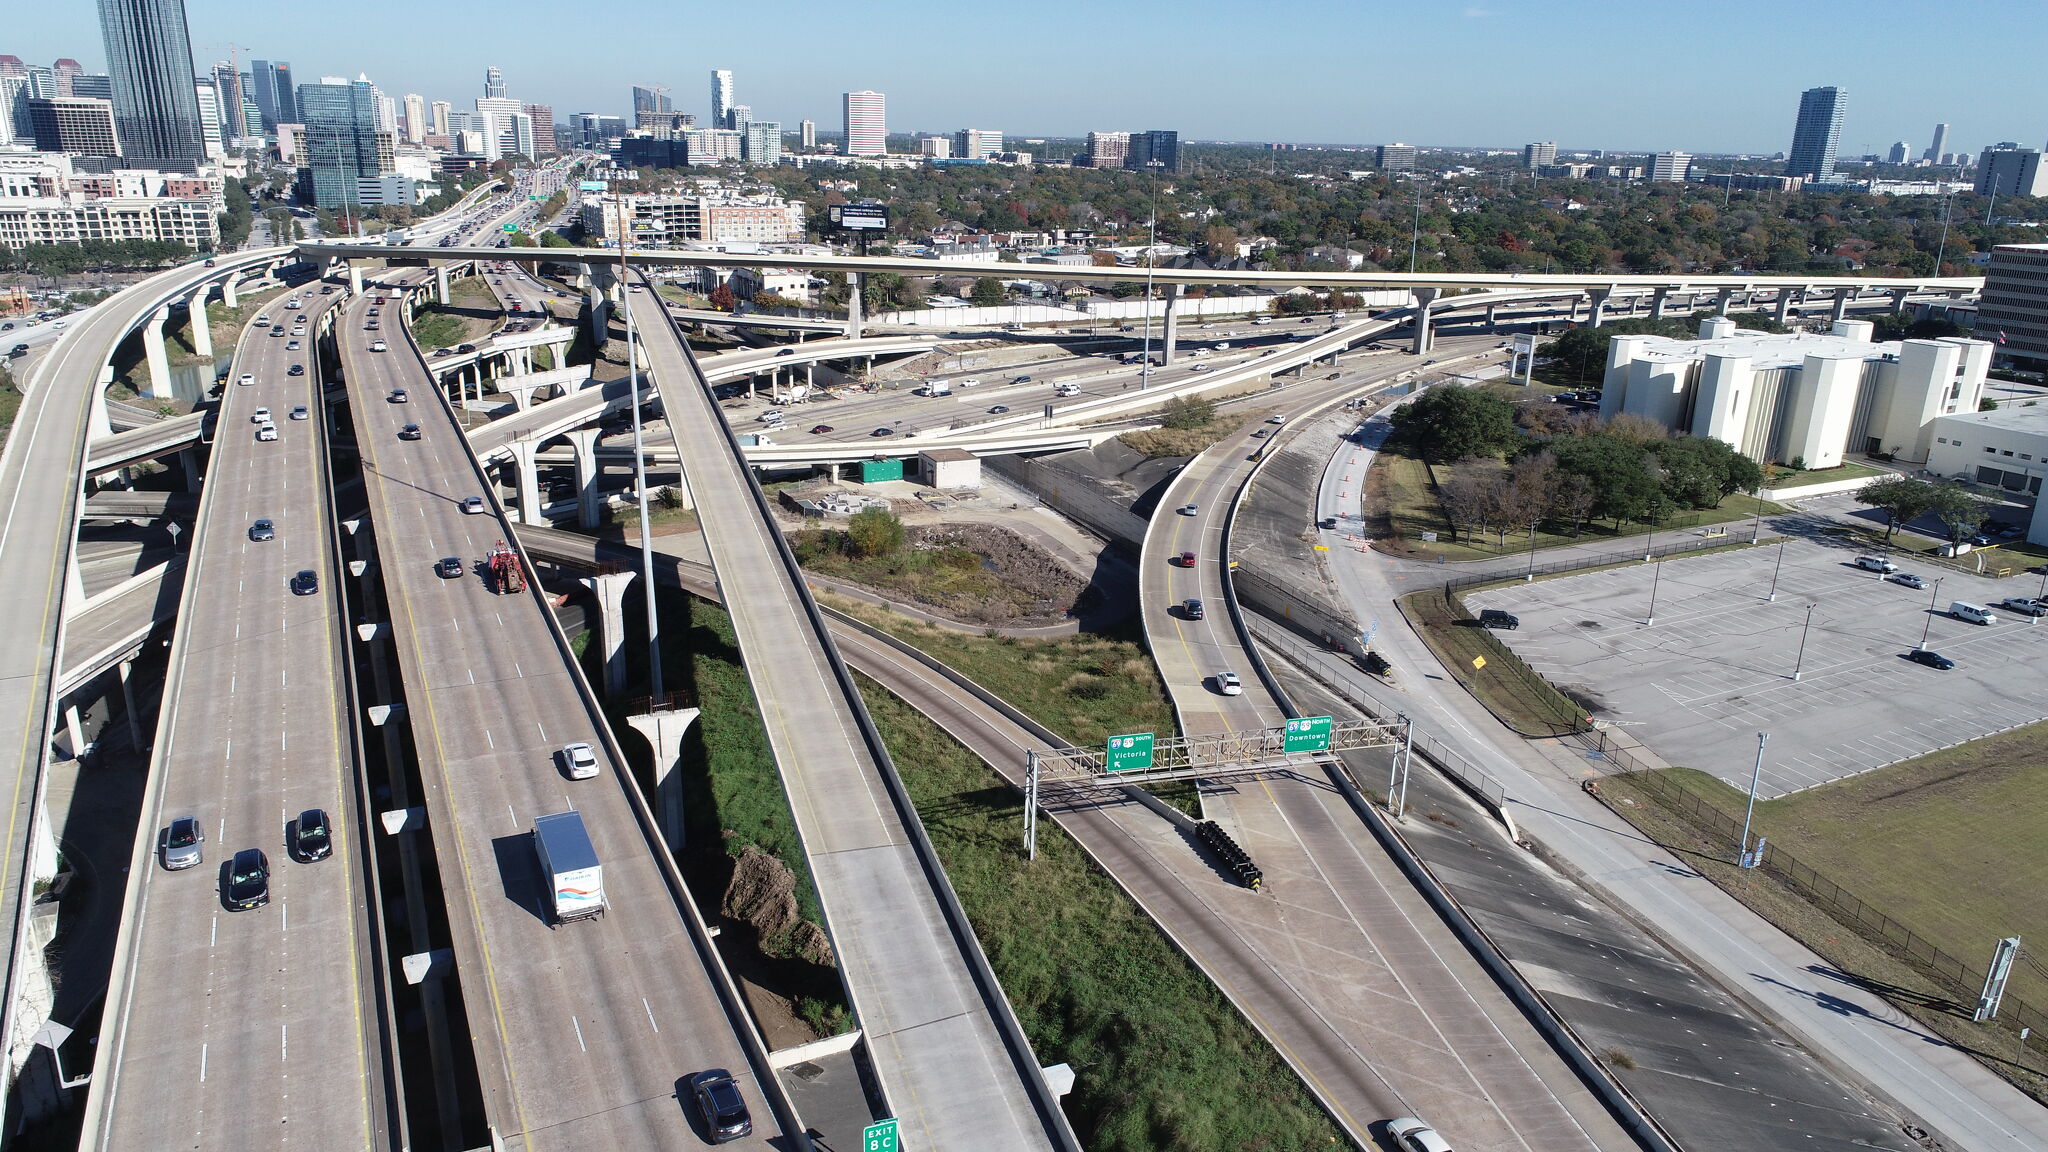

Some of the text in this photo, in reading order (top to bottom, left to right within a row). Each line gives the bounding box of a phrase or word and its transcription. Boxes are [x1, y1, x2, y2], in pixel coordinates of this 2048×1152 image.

[1302, 722, 1310, 730] 59
[1289, 733, 1326, 742] Downtown
[1114, 750, 1146, 759] Victoria
[868, 1126, 893, 1138] EXIT
